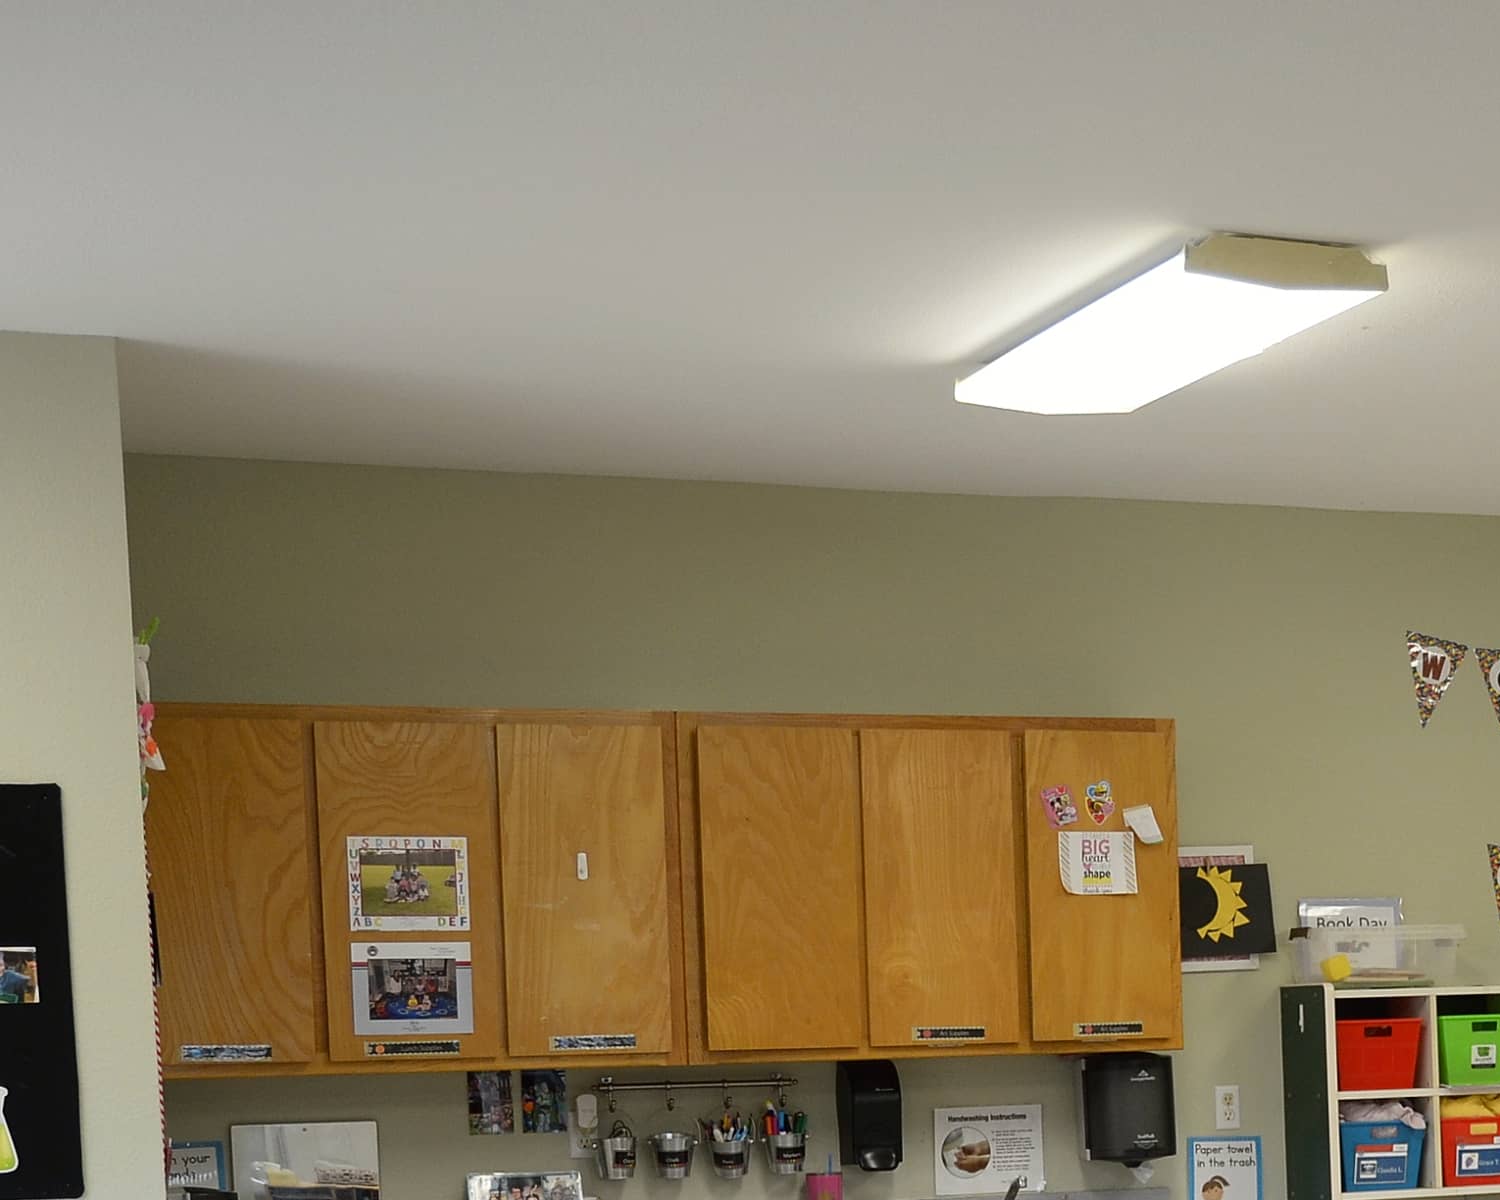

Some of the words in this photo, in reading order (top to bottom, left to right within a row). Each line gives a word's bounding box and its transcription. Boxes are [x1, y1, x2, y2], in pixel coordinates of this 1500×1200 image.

[1081, 839, 1110, 855] BIG
[1084, 869, 1111, 878] shape
[1195, 1144, 1223, 1156] Paper
[1227, 1143, 1253, 1154] towel
[182, 1155, 211, 1167] your
[1197, 1159, 1206, 1167] in
[1209, 1158, 1225, 1167] the
[1229, 1156, 1256, 1167] trash
